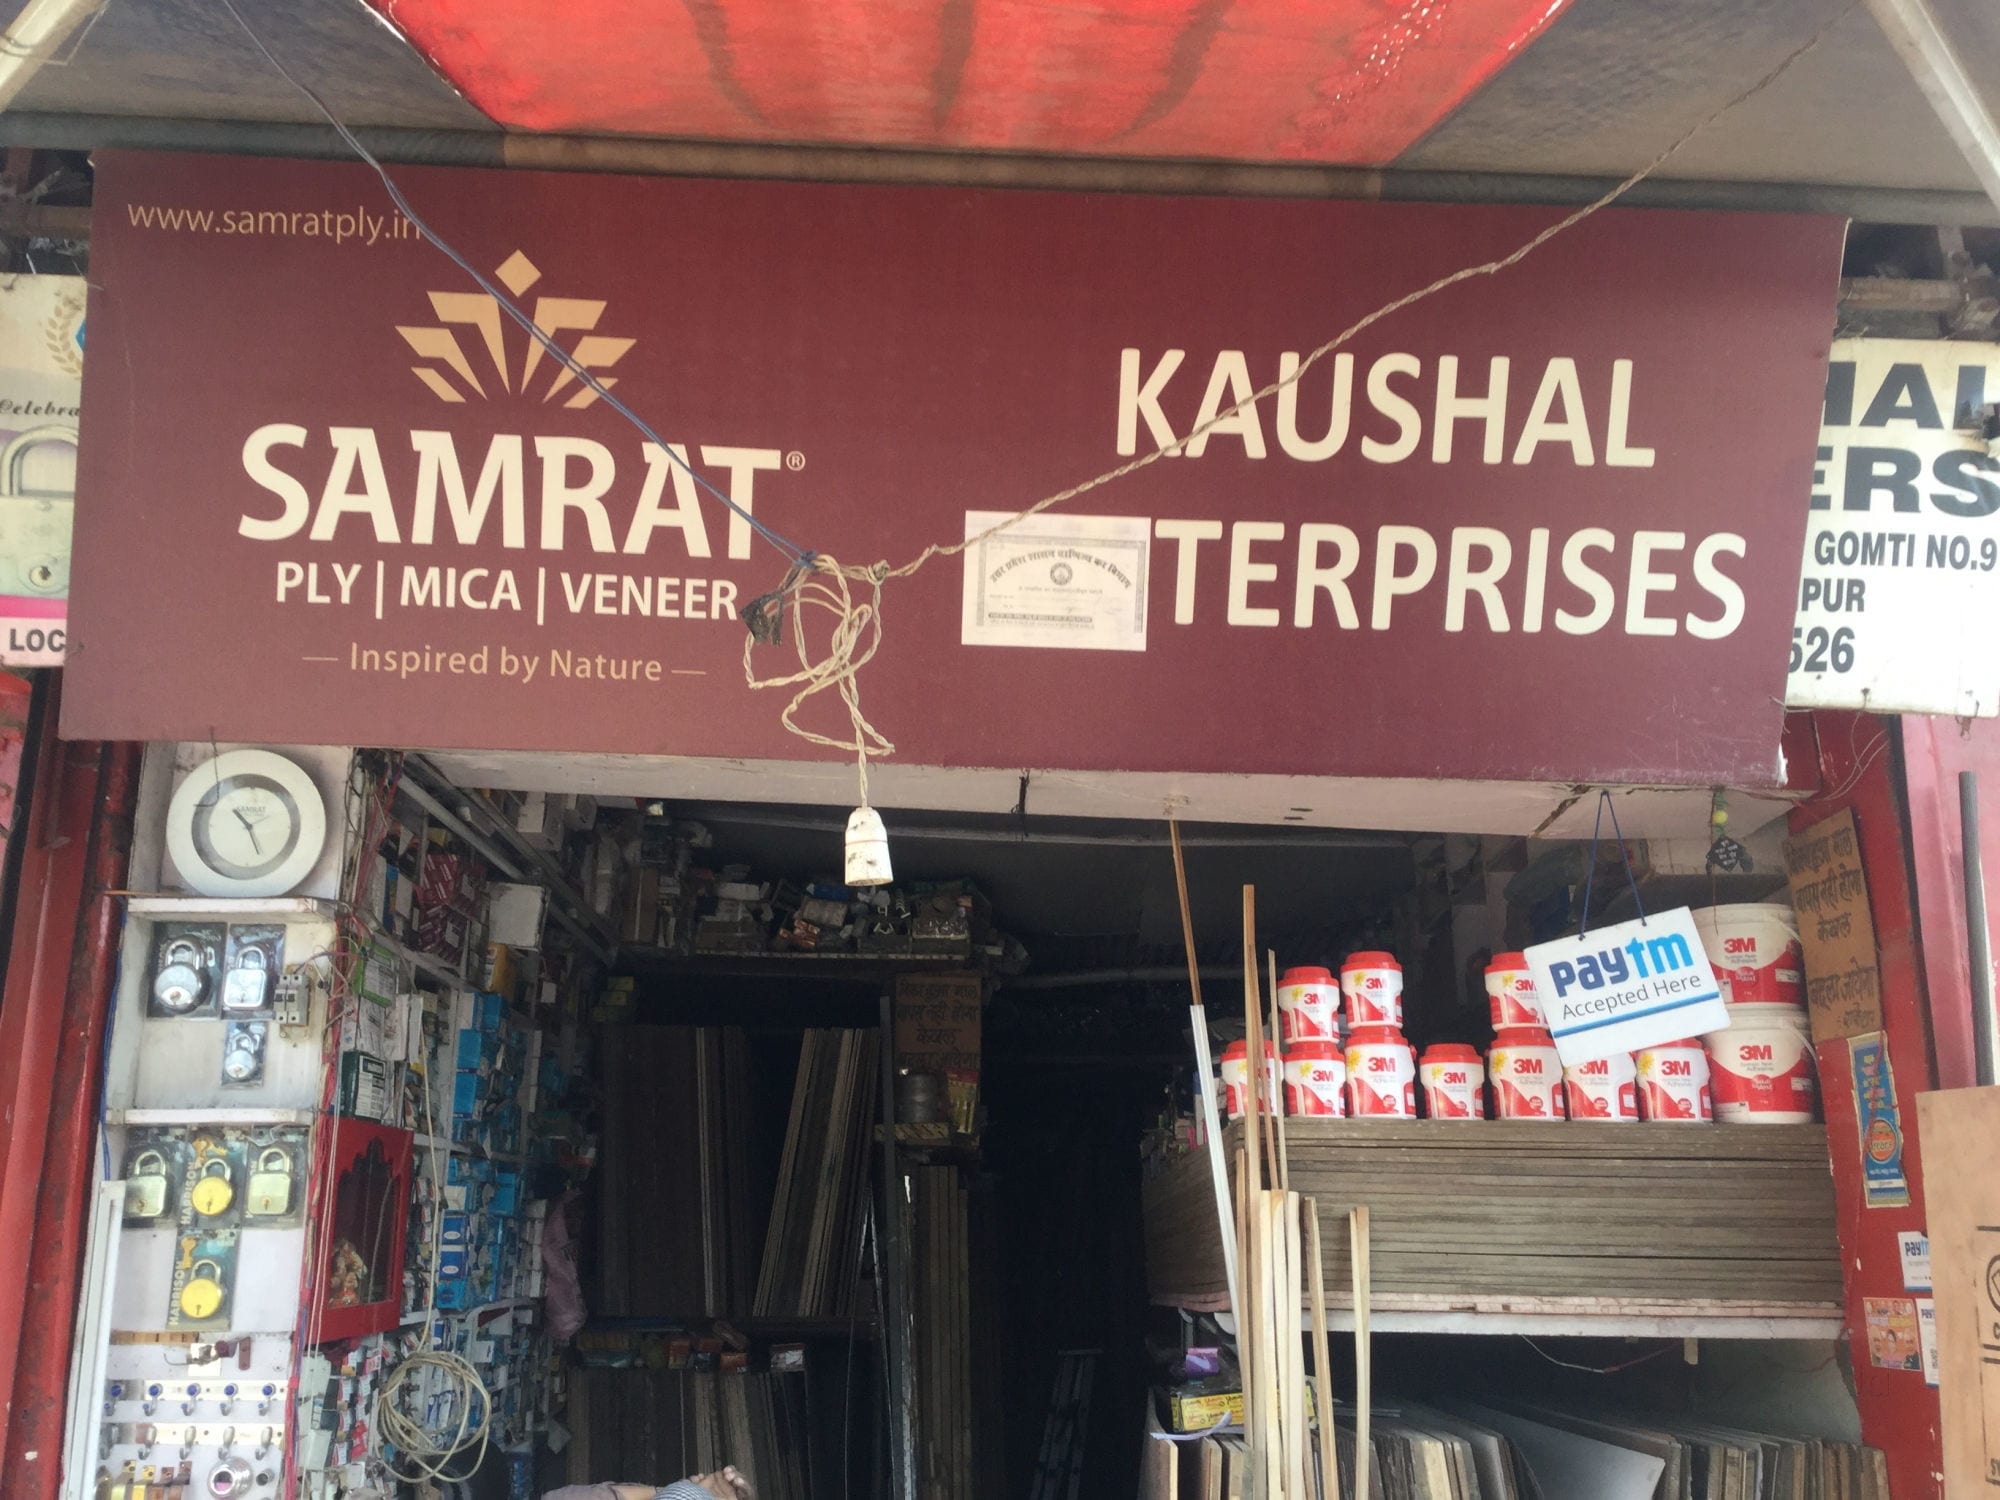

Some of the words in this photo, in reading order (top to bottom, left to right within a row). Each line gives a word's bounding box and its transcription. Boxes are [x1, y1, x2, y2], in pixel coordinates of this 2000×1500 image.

[128, 204, 421, 245] www.samratply.in
[1116, 348, 1656, 467] KAUSHAL
[238, 423, 782, 560] SAMRAT
[1814, 530, 1916, 567] GOMTI
[1925, 535, 1998, 572] NO.9
[276, 561, 362, 604] PLY
[400, 566, 522, 611] MICA
[560, 572, 738, 621] VENEER
[1801, 578, 1866, 613] PUR
[9, 628, 65, 652] LOC
[350, 642, 489, 679] Inspired
[500, 644, 539, 684] by
[550, 650, 662, 682] Nature
[1724, 937, 1756, 953] 3M
[1562, 982, 1649, 1020] Accepted
[1654, 975, 1702, 997] Here
[1368, 1057, 1396, 1072] 3M
[1513, 1058, 1543, 1074] 3M
[1739, 1045, 1772, 1060] 3M
[1312, 1070, 1333, 1082] 3M
[1443, 1072, 1466, 1084] 3M
[1661, 1060, 1691, 1075] 3M
